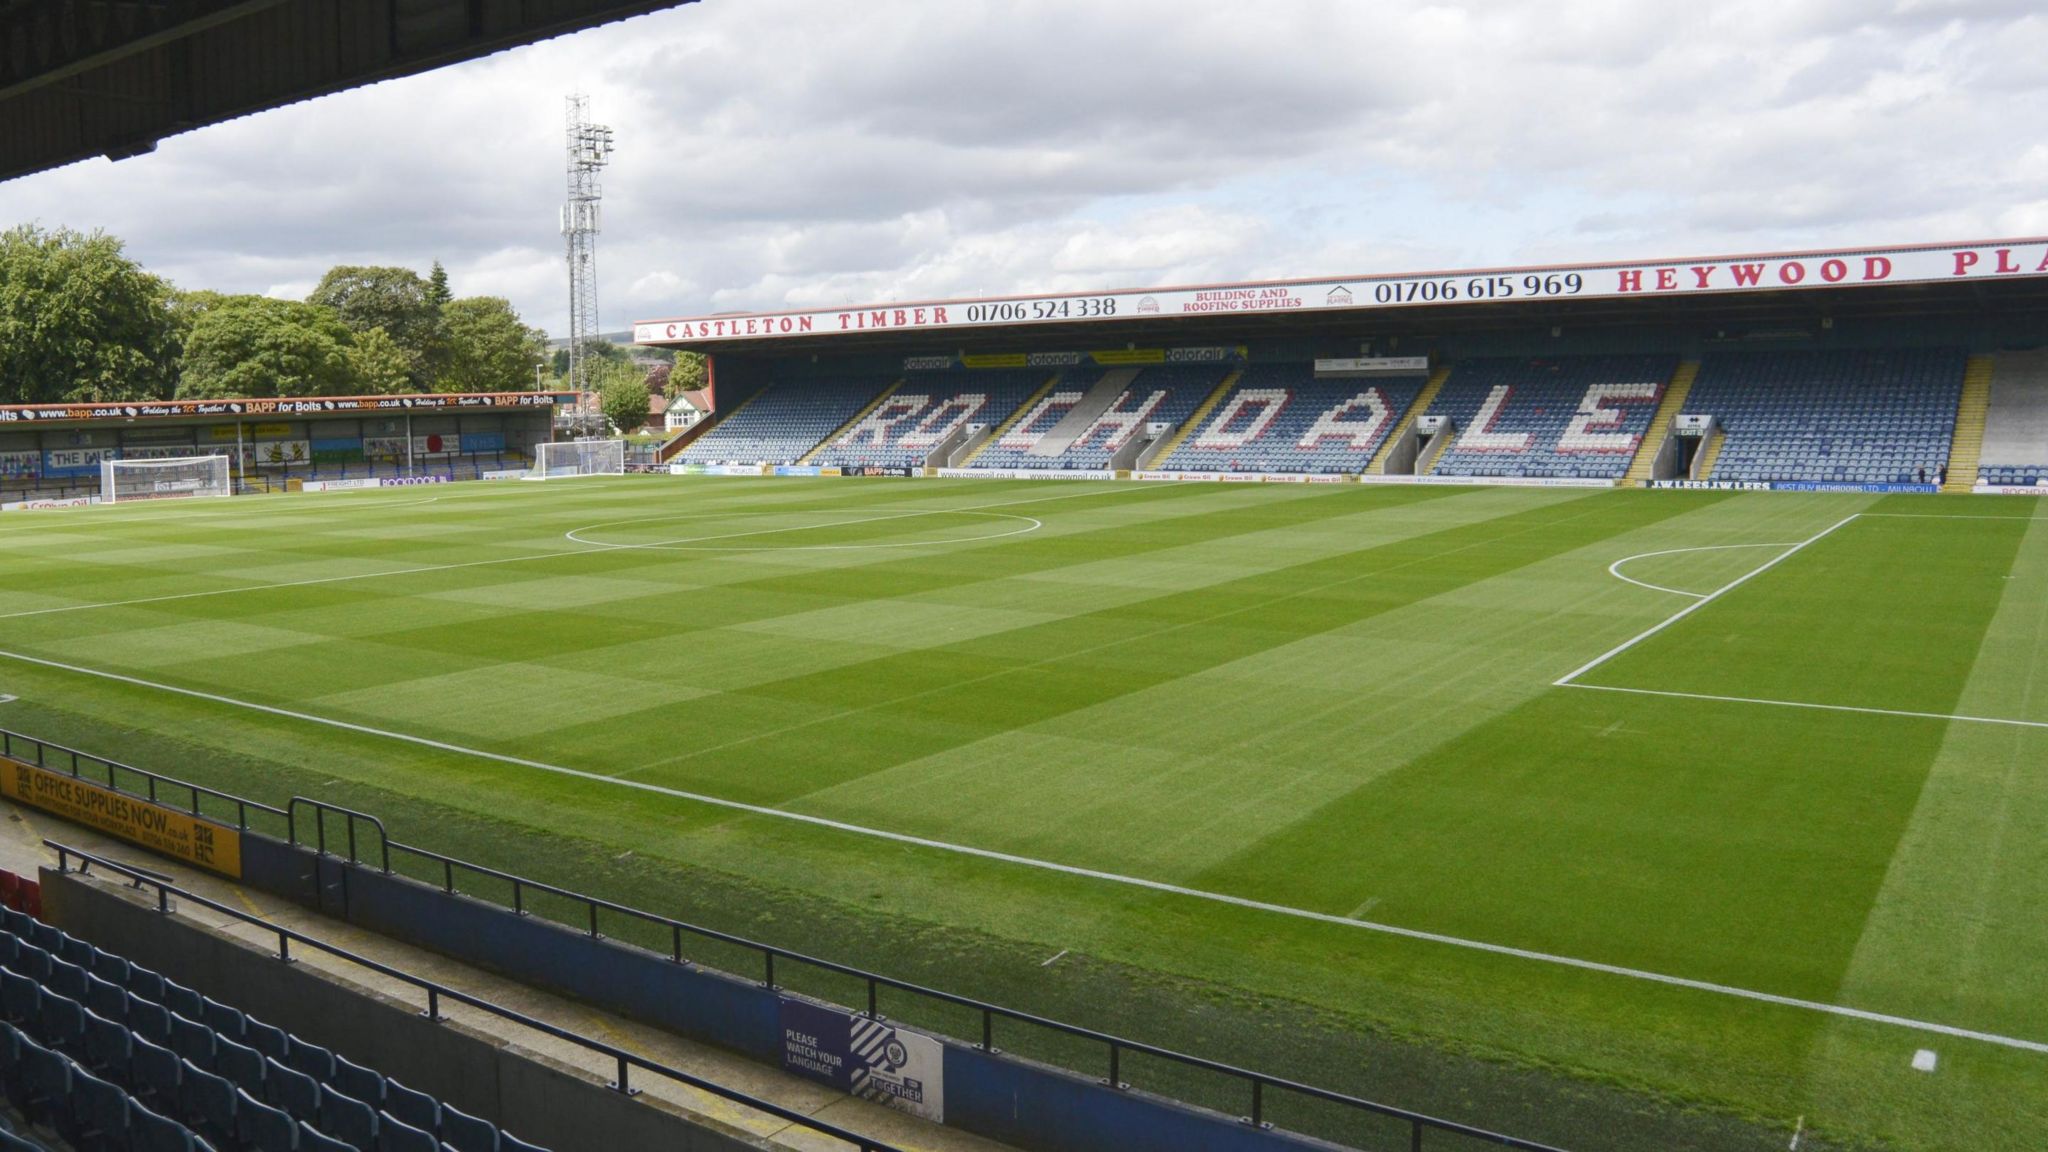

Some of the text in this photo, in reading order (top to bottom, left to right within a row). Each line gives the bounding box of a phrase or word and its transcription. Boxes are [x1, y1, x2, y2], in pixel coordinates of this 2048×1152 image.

[1616, 256, 1893, 292] HEYWOOD
[1195, 288, 1288, 302] BUILDING AND
[1375, 273, 1583, 304] 01706 615 969
[967, 298, 1117, 322] 01706 524 338
[1183, 297, 1302, 312] ROOFING SUPPLIES
[666, 307, 949, 339] CASTLETON TIMBER
[246, 401, 321, 413] BAPP for Bolts
[338, 399, 400, 409] www.bapp.co.uk
[494, 395, 554, 406] BAPP for Bolts
[39, 407, 122, 418] www.bapp.co.uk
[171, 404, 181, 413] the
[53, 452, 80, 466] THE
[864, 467, 883, 475] BAPP
[382, 476, 436, 487] ROCKDOOR
[1674, 480, 1709, 490] LEES
[1734, 481, 1771, 491] LEES
[1776, 483, 1797, 491] BEST
[1815, 484, 1863, 492] BATHROOMS
[34, 773, 73, 802] OFFICE
[74, 785, 129, 820] SUPPLIES
[131, 807, 167, 833] NOW
[786, 1029, 818, 1047] PLEASE
[786, 1041, 842, 1067] WATCH YOUR
[787, 1054, 833, 1076] LANGUAGE
[872, 1078, 922, 1101] TOGETHER
